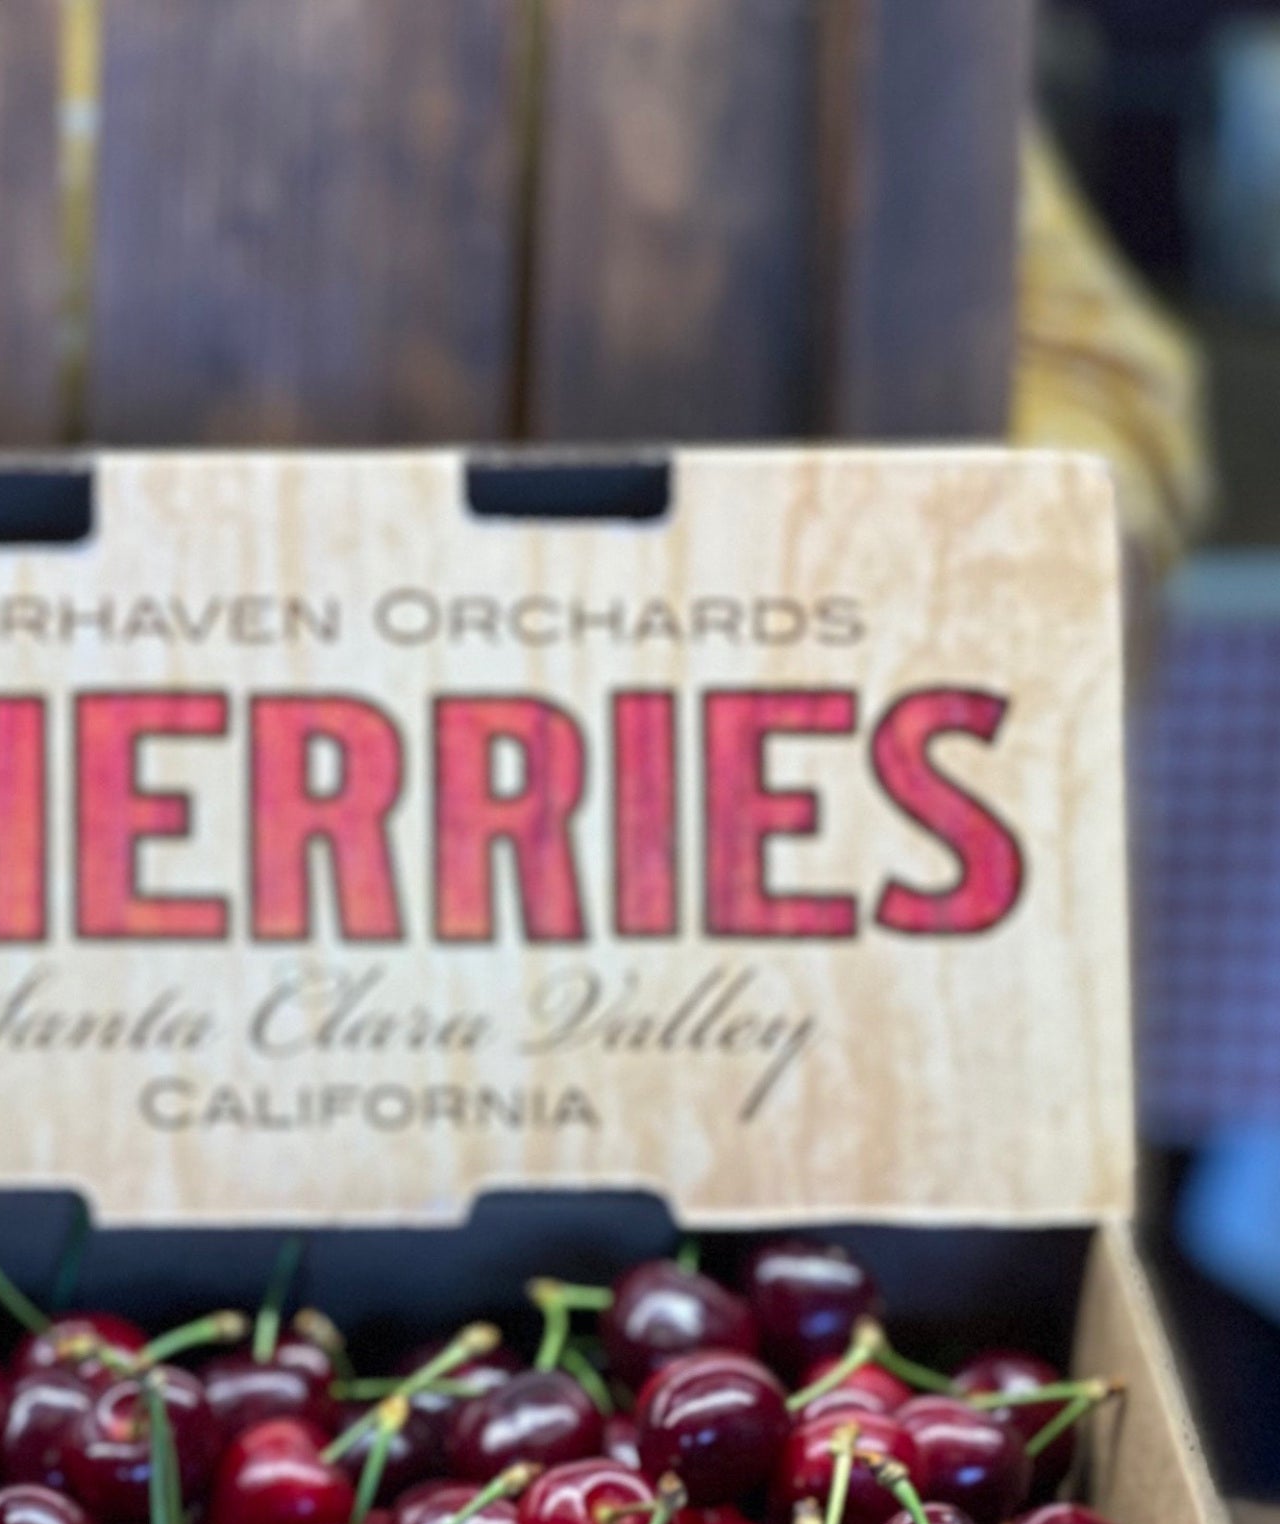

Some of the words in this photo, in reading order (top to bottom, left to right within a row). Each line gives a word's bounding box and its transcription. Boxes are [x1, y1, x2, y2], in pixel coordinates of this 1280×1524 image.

[373, 587, 867, 647] ORCHARDS
[246, 960, 497, 1056] Clara
[517, 962, 818, 1122] Valley
[137, 1077, 604, 1133] CALIFORNIA
